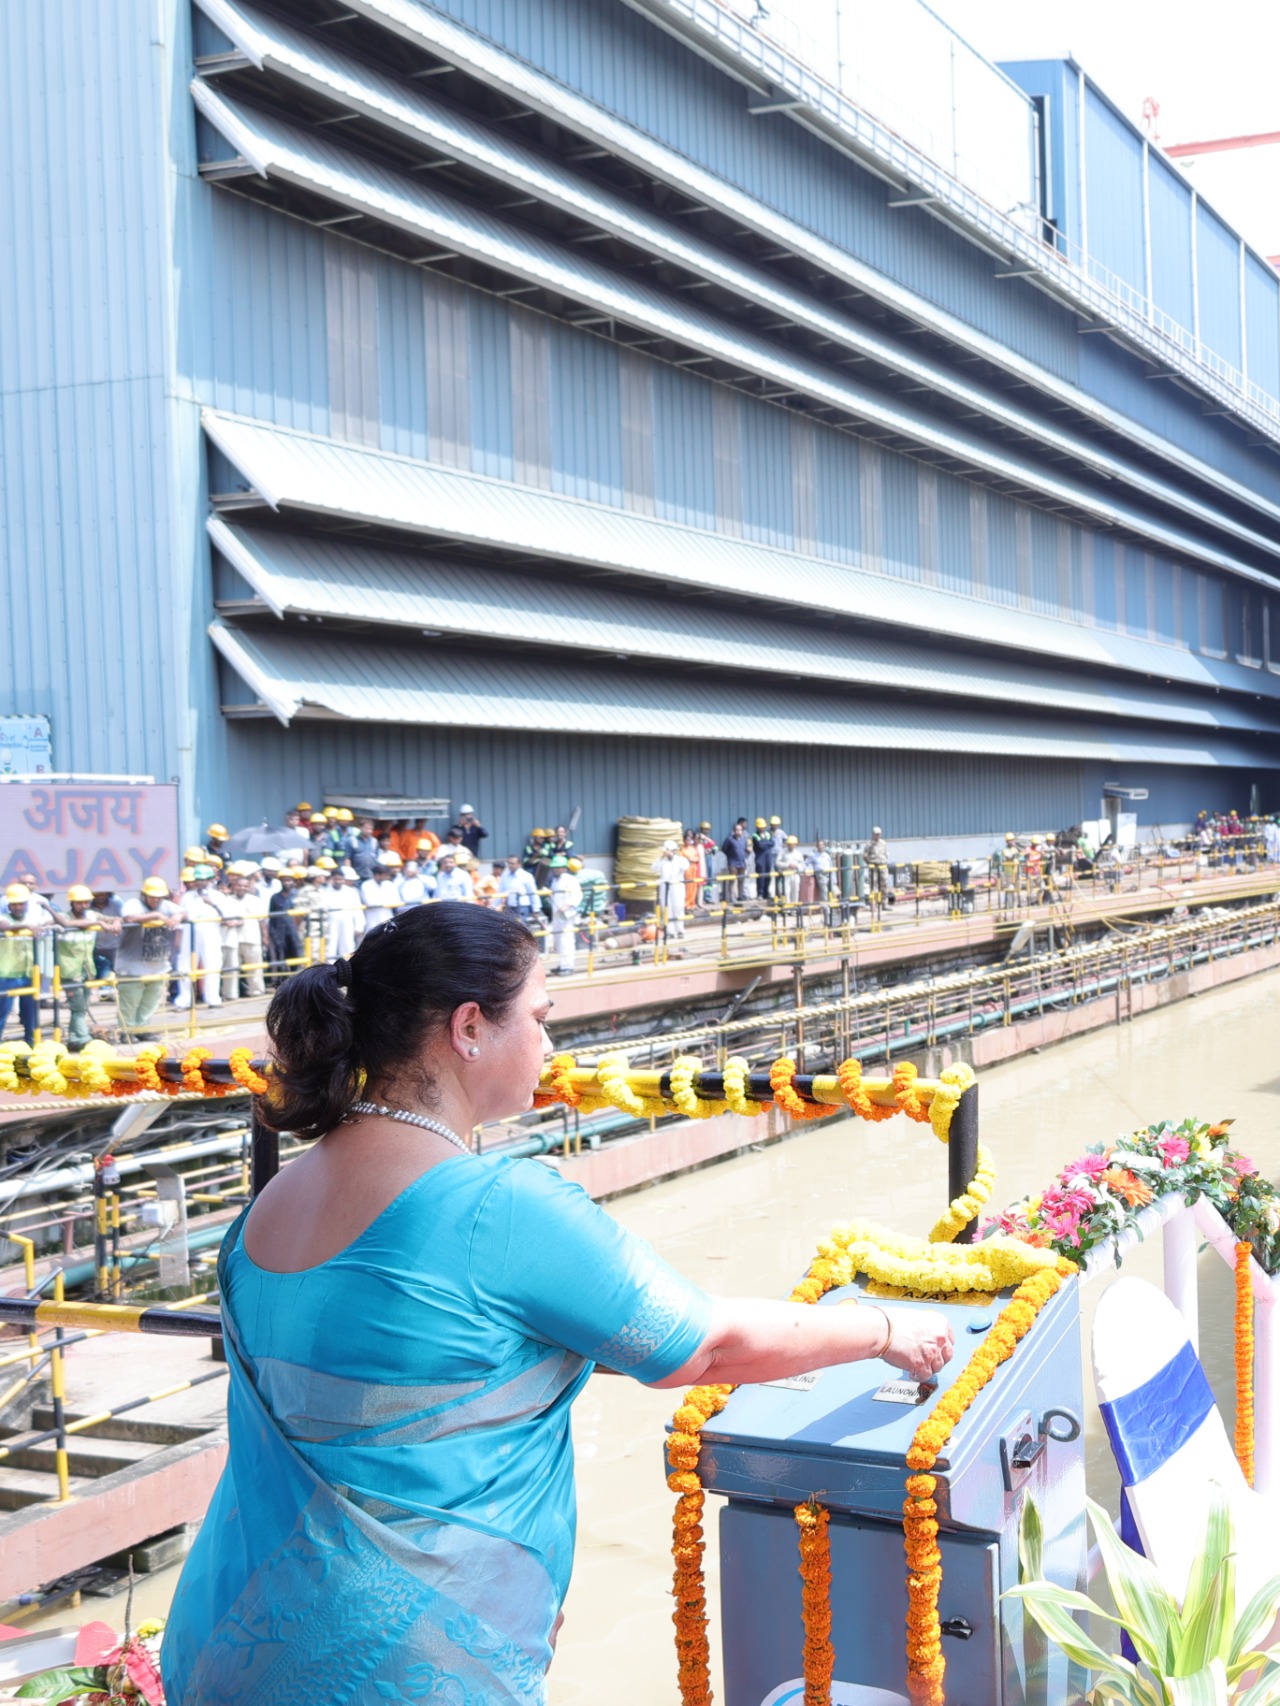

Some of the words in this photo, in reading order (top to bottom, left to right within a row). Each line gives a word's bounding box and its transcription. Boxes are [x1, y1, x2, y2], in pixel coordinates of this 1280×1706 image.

[22, 788, 147, 836] अजय
[0, 847, 172, 888] AJAY
[901, 1290, 954, 1301] AJAY
[879, 1386, 931, 1399] LAUNCHING
